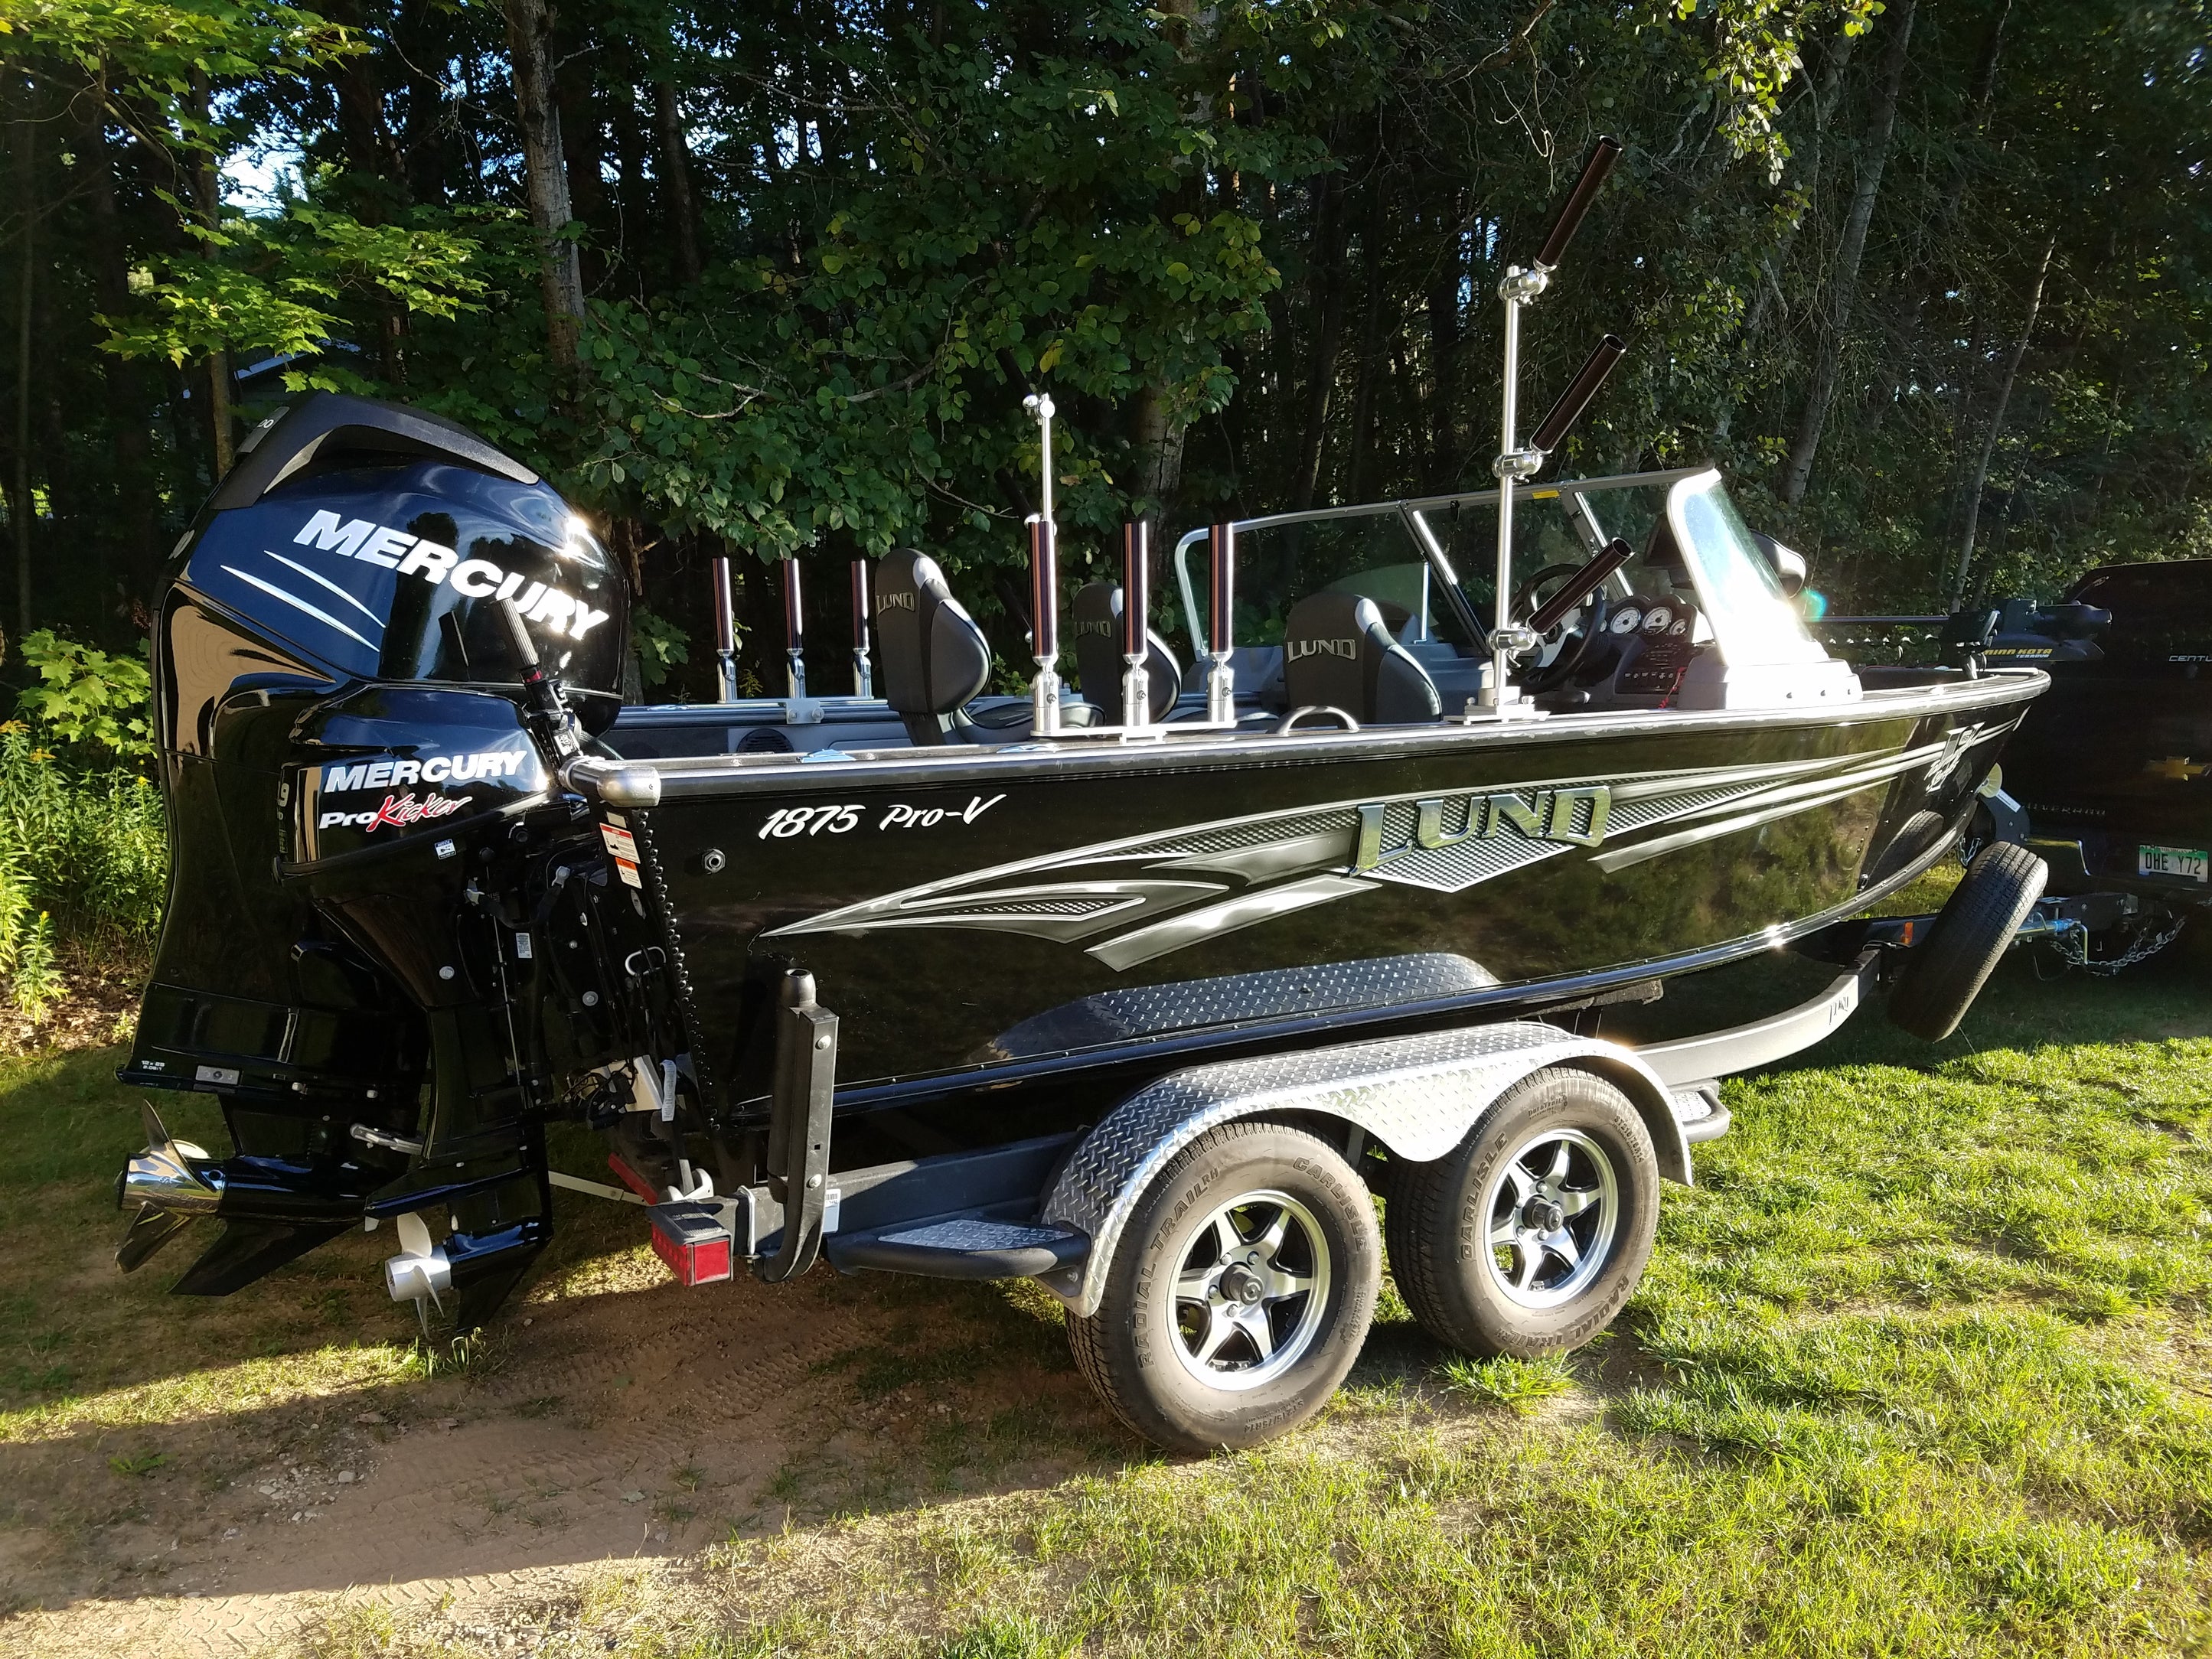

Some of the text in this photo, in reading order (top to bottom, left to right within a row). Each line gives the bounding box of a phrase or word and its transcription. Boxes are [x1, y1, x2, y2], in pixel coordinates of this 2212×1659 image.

[292, 508, 610, 641] MERCURY
[875, 592, 915, 616] LUND
[1074, 621, 1111, 640] LUND
[1287, 638, 1356, 664] LUND
[323, 750, 528, 794] MERCURY
[759, 794, 1007, 840] 1875 Pro-V
[1349, 785, 1612, 878] LUND
[2178, 856, 2201, 875] Y72
[1292, 1156, 1368, 1252] CARLISLE
[1460, 1132, 1509, 1260] CARLISLE
[1133, 1263, 1157, 1369] RADIAL
[1150, 1182, 1209, 1252] TRAIL
[1570, 1275, 1630, 1339] RADIAL
[1510, 1330, 1564, 1348] TRAIL
